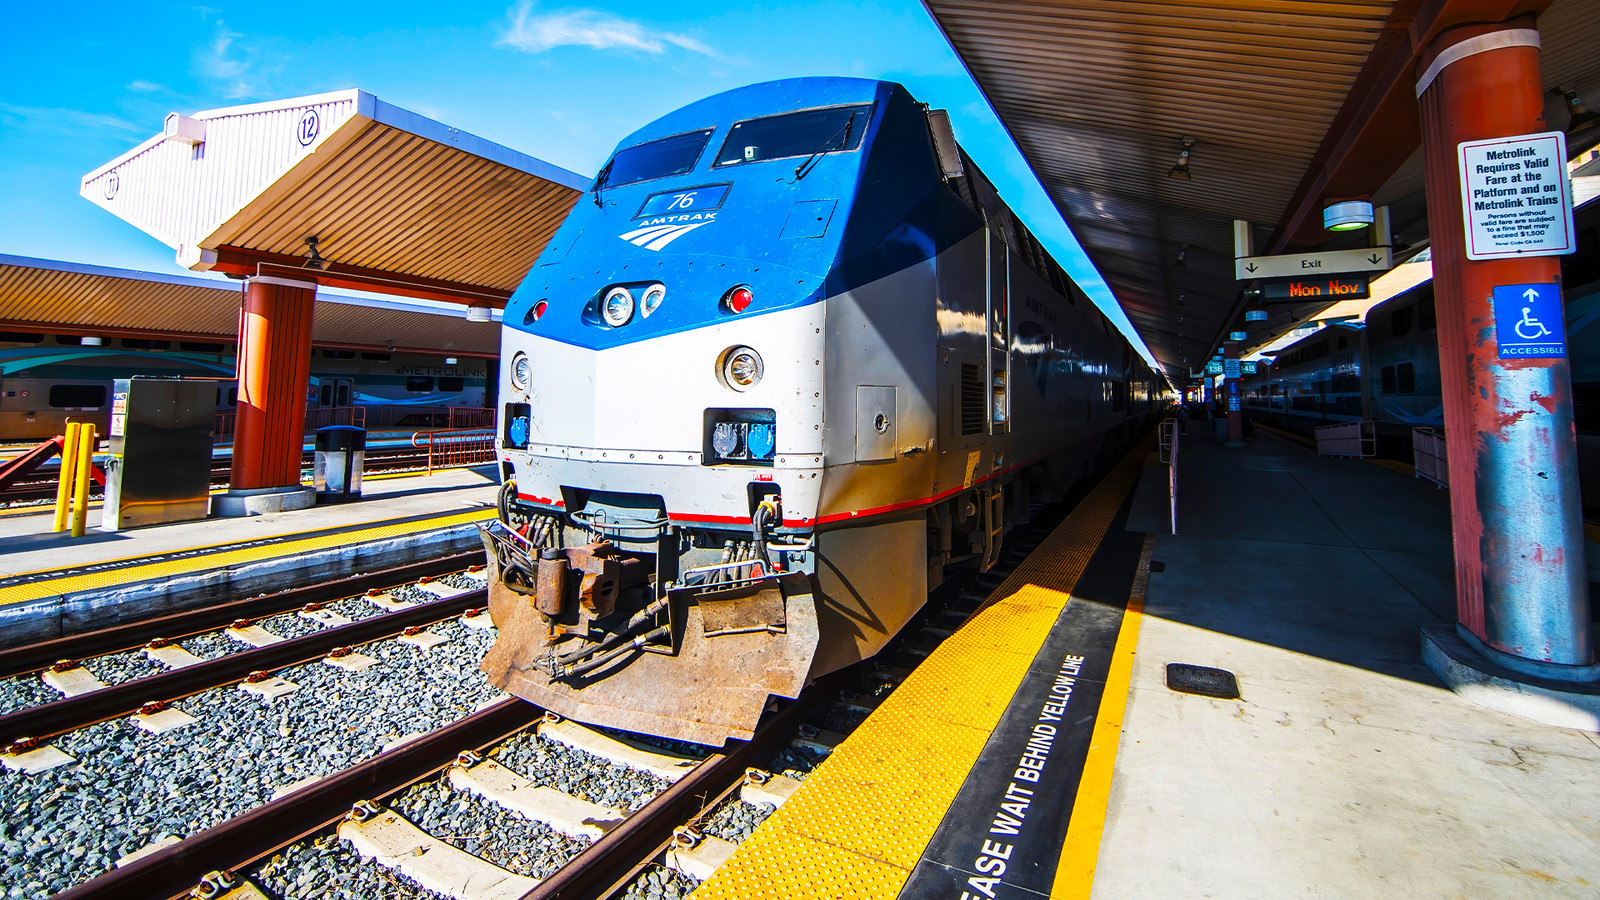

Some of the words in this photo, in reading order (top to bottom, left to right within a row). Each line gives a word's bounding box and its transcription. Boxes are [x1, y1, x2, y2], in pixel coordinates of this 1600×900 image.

[302, 116, 315, 140] 12
[1486, 147, 1536, 161] Metrolink
[1476, 162, 1521, 174] Requires
[1524, 158, 1549, 169] Valid
[1485, 175, 1508, 185] Fare
[1511, 173, 1522, 183] at
[1524, 171, 1541, 181] the
[1474, 187, 1517, 199] Platform
[1520, 184, 1540, 195] and
[1543, 184, 1556, 192] on
[667, 192, 697, 210] 76
[1474, 198, 1524, 211] Metrolink
[1526, 195, 1558, 207] Trains
[639, 212, 718, 226] AMTRAK
[1480, 219, 1497, 227] valid
[1528, 215, 1556, 224] subject
[1488, 211, 1517, 219] Persons
[1518, 209, 1547, 217] without
[1533, 223, 1550, 231] may
[1301, 259, 1322, 269] Exit
[1290, 282, 1321, 297] Mon
[1329, 280, 1359, 295] Nov
[1502, 347, 1564, 355] ACCESSIBLE
[401, 365, 486, 377] METROLINK
[989, 782, 1034, 835] WAIT
[1014, 723, 1057, 783] BEHIND
[1039, 674, 1076, 722] YELLOW
[1060, 654, 1085, 677] LINE
